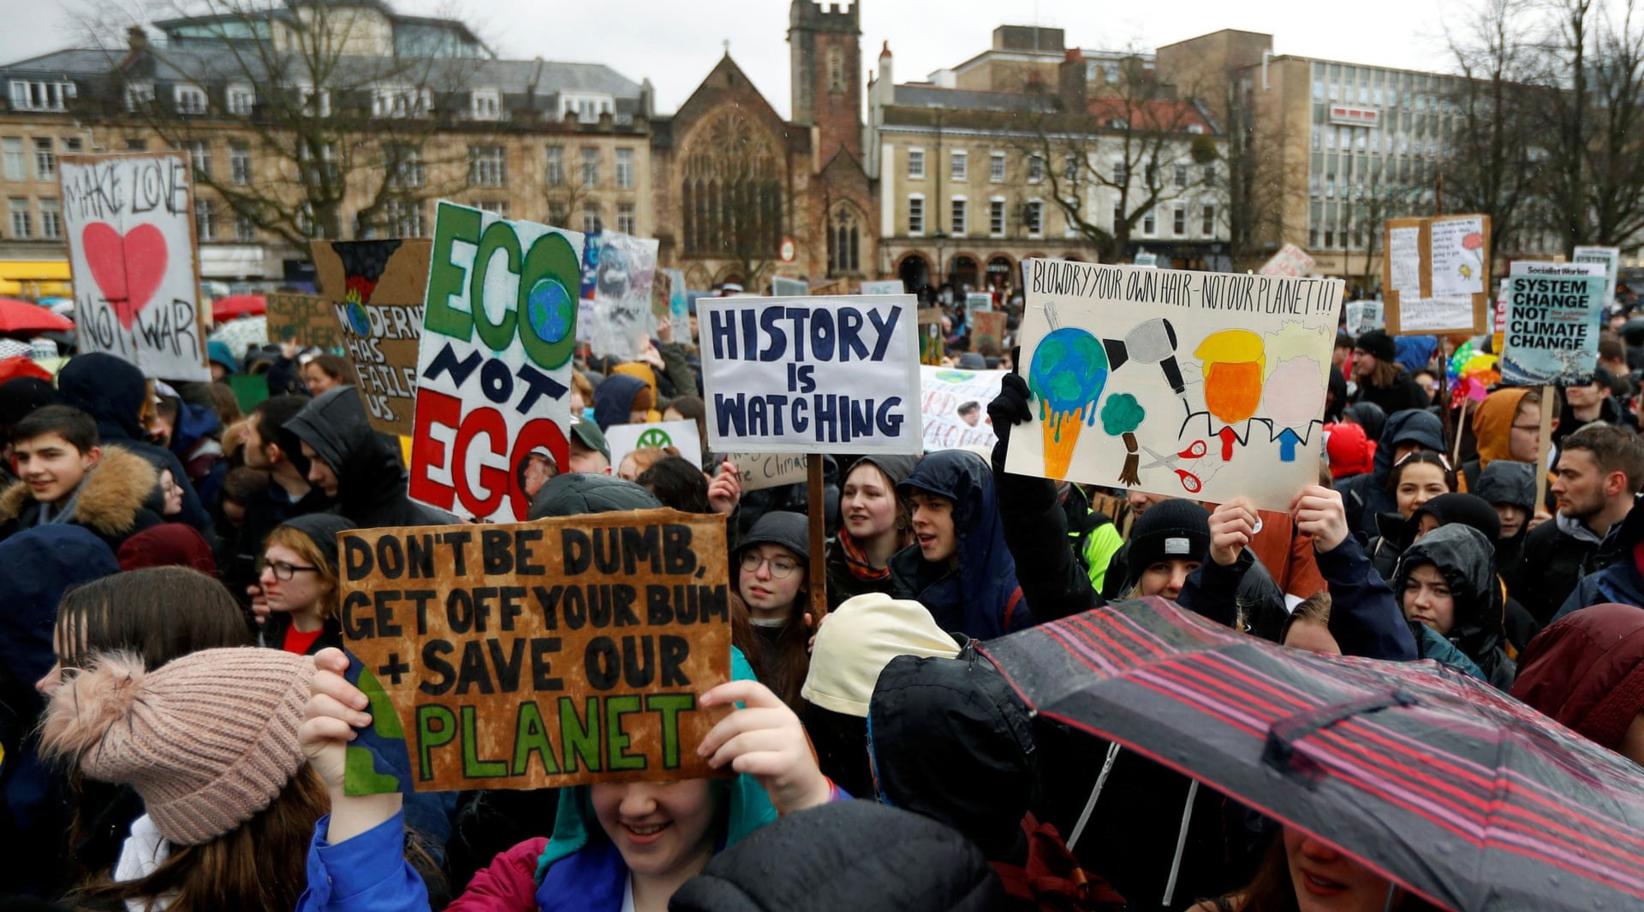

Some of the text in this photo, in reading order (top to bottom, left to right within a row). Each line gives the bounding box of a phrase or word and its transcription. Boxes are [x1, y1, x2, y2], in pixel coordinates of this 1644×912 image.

[65, 157, 189, 222] MAKE LOVE
[424, 202, 581, 371] ECO
[1089, 266, 1122, 300] YOUR
[1126, 271, 1158, 303] OWN
[1160, 273, 1192, 308] HAIR
[1202, 275, 1228, 310] NOT
[1227, 276, 1254, 312] OUR
[1514, 278, 1587, 294] SYSTEM
[1528, 266, 1589, 275] Socialist Worker
[334, 303, 424, 339] MODERN
[1512, 306, 1548, 321] NOT
[1513, 292, 1589, 309] CHANGE
[80, 294, 198, 361] NOT WAR
[346, 338, 385, 363] HAS
[709, 305, 902, 362] HISTORY
[1509, 334, 1586, 350] CHANGE
[1510, 320, 1588, 337] CLIMATE
[355, 364, 418, 398] FAILE
[422, 341, 569, 415] NOT
[787, 363, 816, 393] IS
[714, 393, 904, 443] WATCHING
[408, 386, 570, 522] EGO
[763, 453, 808, 479] Climat
[345, 524, 706, 582] DON'T BE DUMB,
[342, 584, 730, 641] GET OFF YOUR BUM
[418, 637, 565, 696] SAVE
[584, 635, 691, 691] OUR
[415, 692, 696, 782] PLANET
